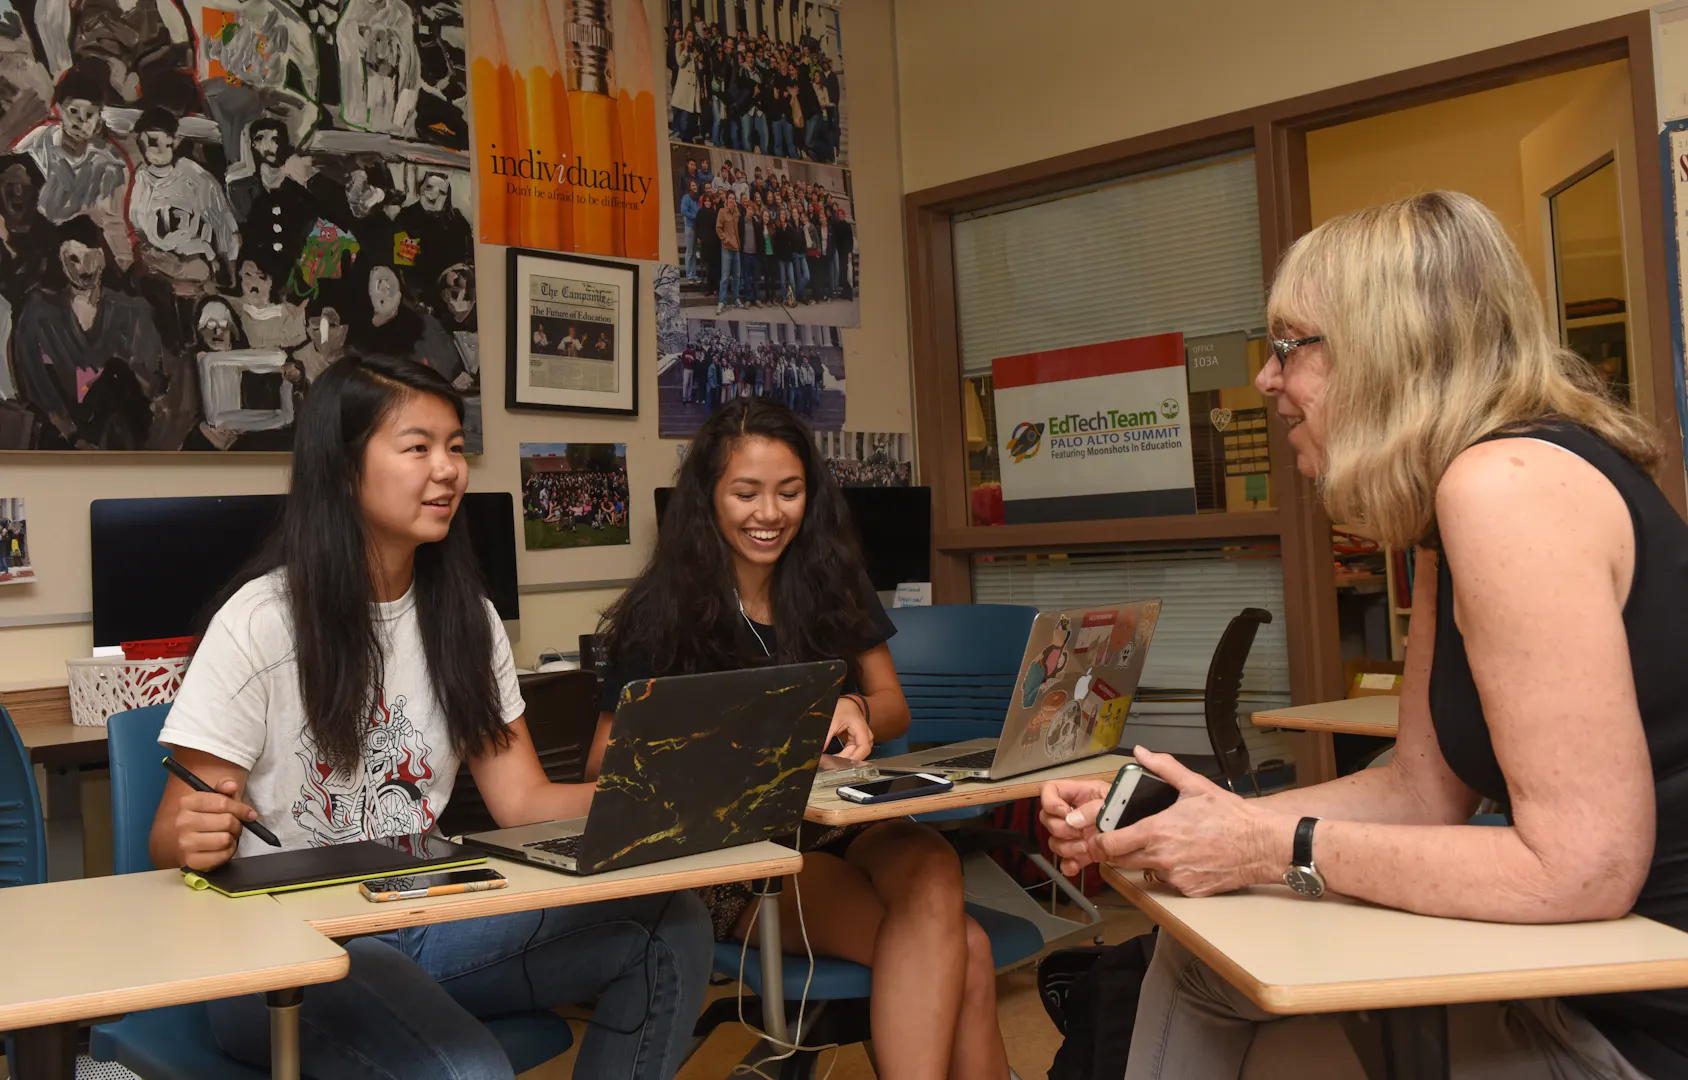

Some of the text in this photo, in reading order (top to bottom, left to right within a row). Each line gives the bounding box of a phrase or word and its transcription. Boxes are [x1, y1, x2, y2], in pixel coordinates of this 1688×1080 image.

[491, 143, 652, 204] individuality
[506, 182, 531, 197] Don't
[534, 186, 546, 199] be
[548, 188, 574, 203] afraid
[577, 194, 587, 204] to
[588, 194, 600, 205] be
[541, 282, 558, 300] The
[531, 306, 612, 324] The Future of Education
[1192, 343, 1215, 354] OFFICE
[1193, 355, 1219, 368] 103A
[1049, 410, 1157, 435] EdTechTeam
[1051, 426, 1180, 449] PALO ALTO SUMMIT
[1051, 439, 1182, 460] Featuring Moonshots In Education
